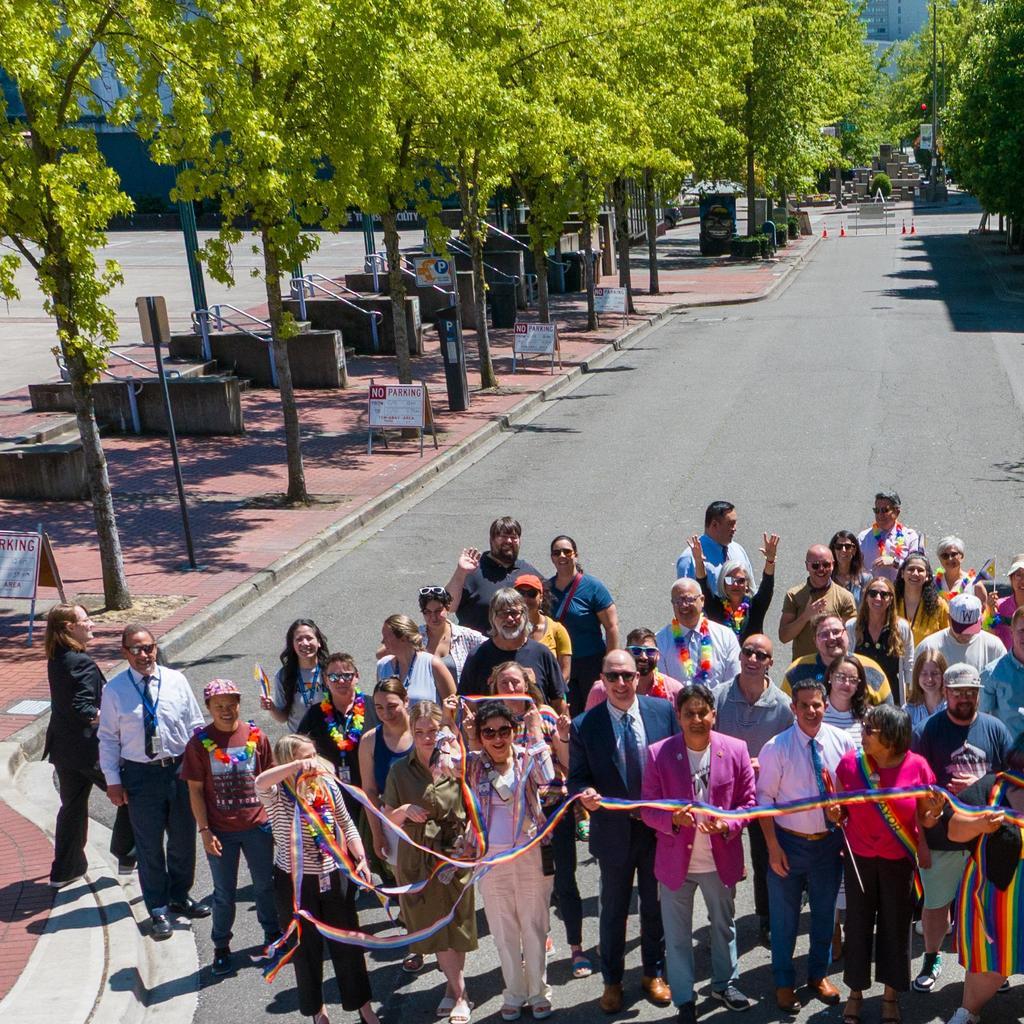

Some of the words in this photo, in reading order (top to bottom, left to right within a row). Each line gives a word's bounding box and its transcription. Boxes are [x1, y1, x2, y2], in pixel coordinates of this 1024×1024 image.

[396, 211, 418, 222] CILITY
[438, 261, 446, 273] P
[446, 321, 453, 332] P
[516, 324, 527, 334] NO
[371, 387, 385, 398] NO
[388, 388, 422, 398] PARKING
[0, 538, 35, 551] RKING
[962, 609, 974, 622] W
